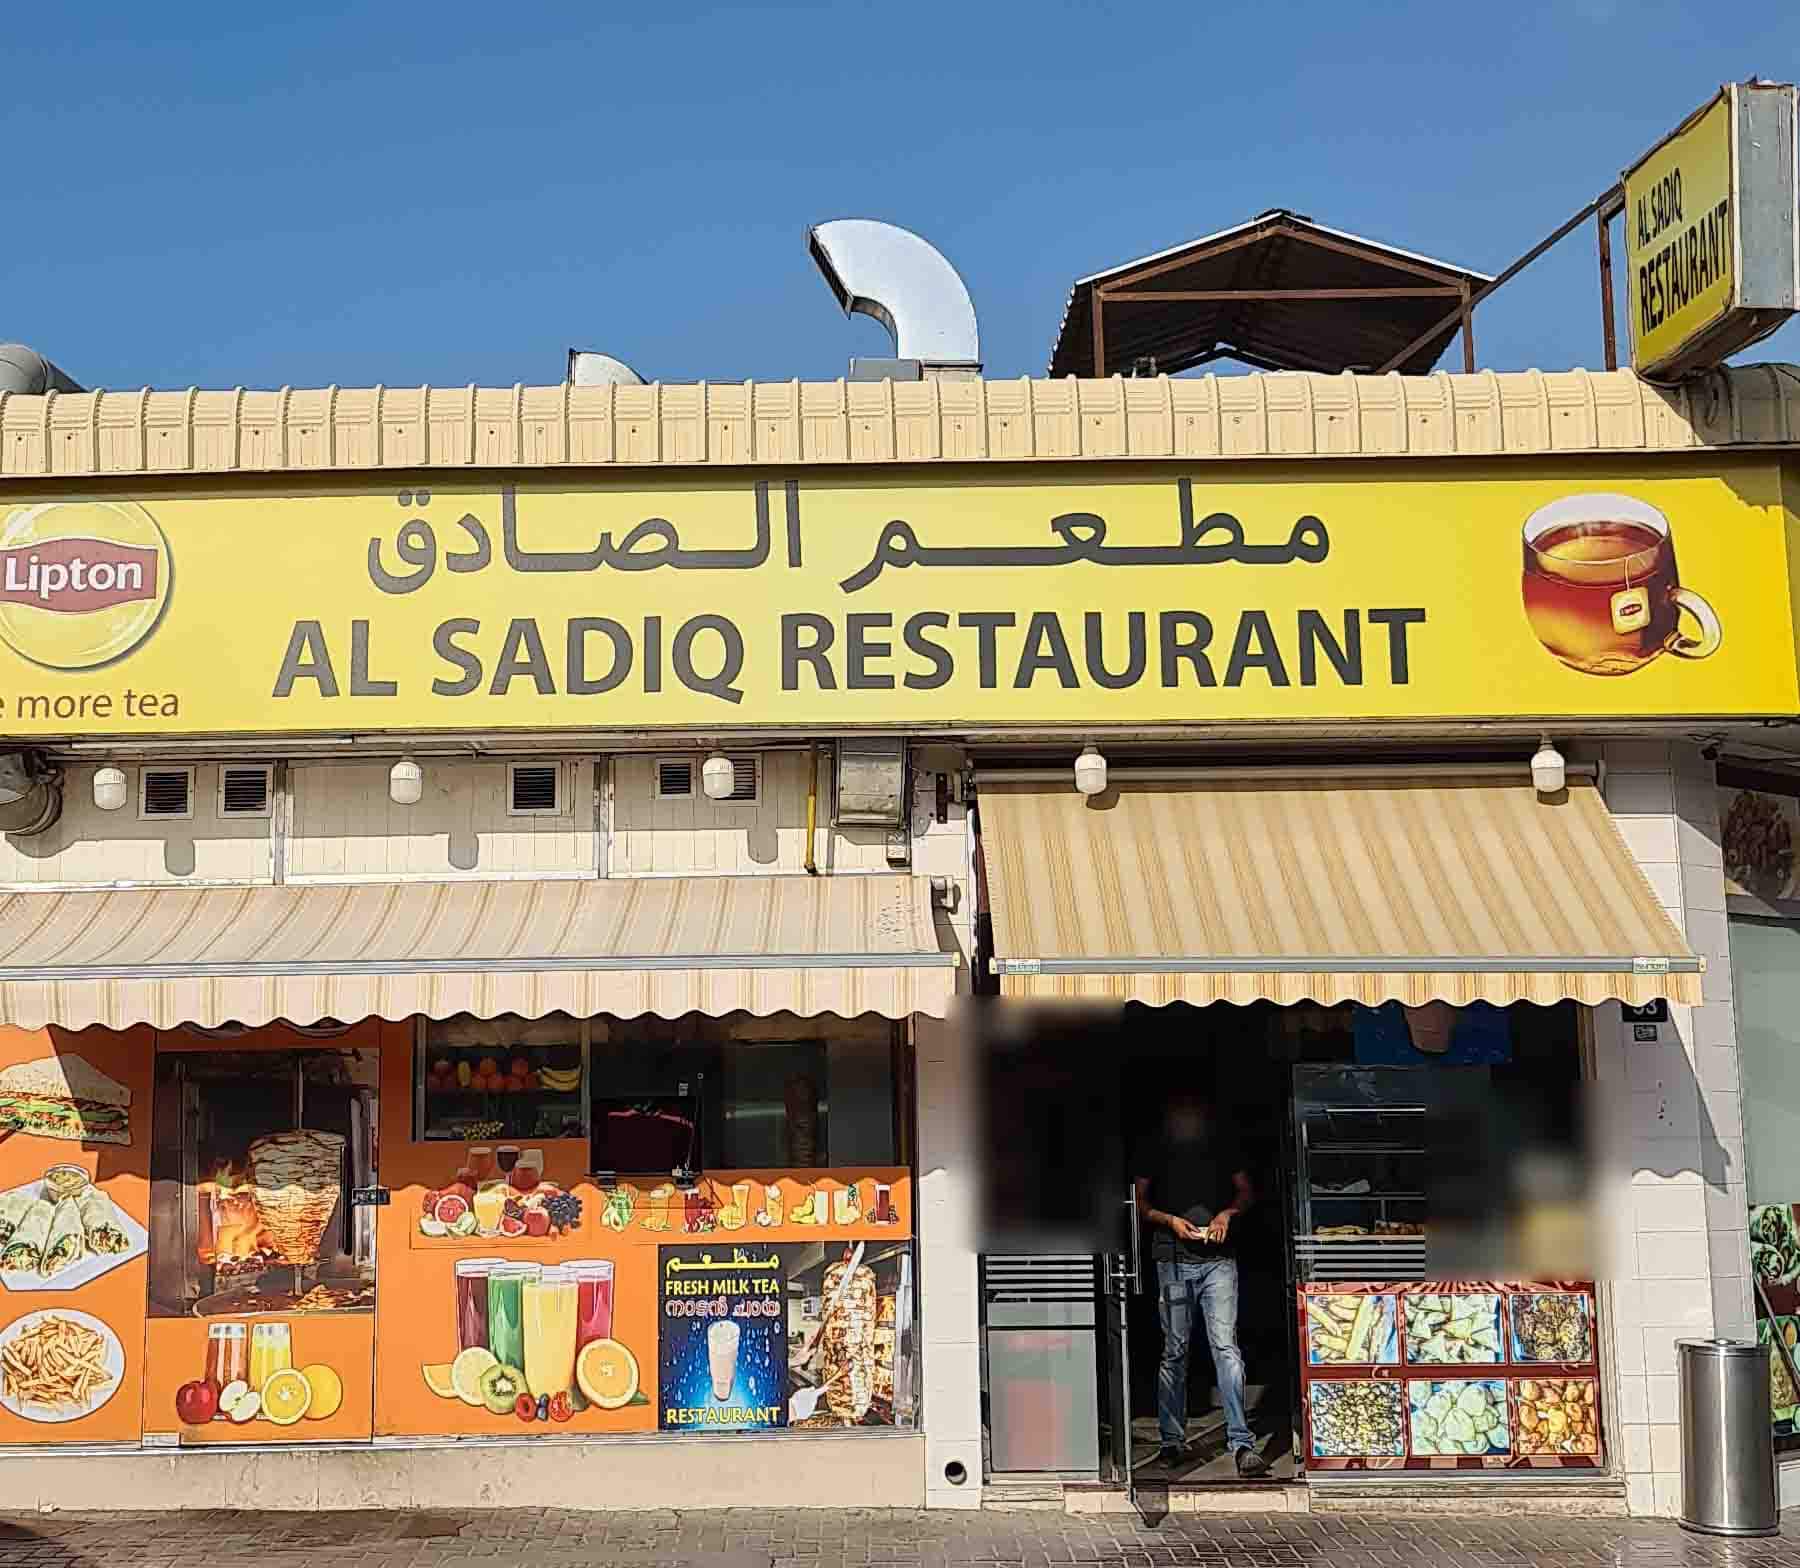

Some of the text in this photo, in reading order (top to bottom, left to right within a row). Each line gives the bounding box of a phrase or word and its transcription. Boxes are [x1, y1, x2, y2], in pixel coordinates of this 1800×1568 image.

[1638, 167, 1683, 247] AL SADIQ
[1639, 199, 1729, 337] RESTAURANT
[368, 478, 1329, 594] مطعم الصادق
[4, 555, 143, 600] Lipton
[272, 608, 1426, 704] AL SADIQ RESTAURANT
[17, 694, 113, 718] more
[124, 689, 179, 717] tea
[666, 1277, 780, 1295] FRESH MILK TEA
[666, 1406, 781, 1424] RESTAURANT
